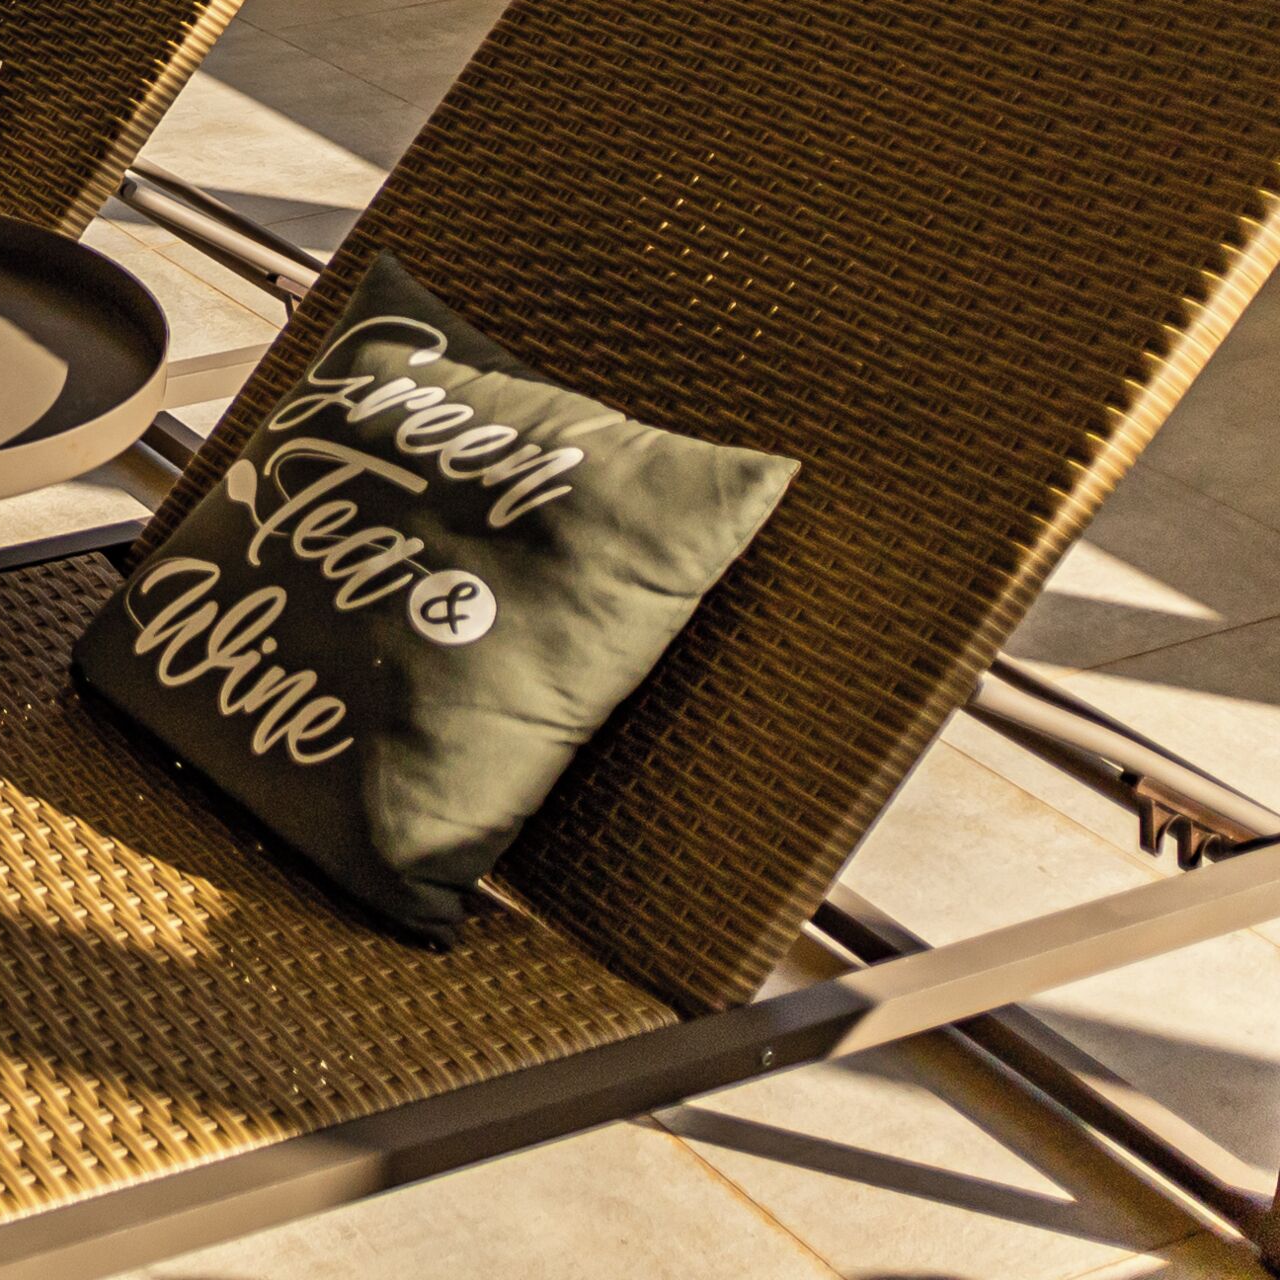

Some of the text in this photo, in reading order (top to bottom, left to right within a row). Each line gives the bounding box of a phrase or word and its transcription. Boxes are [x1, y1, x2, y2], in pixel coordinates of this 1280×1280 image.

[268, 315, 586, 528] Green
[247, 436, 485, 638] Tea &
[130, 556, 355, 765] Wine
